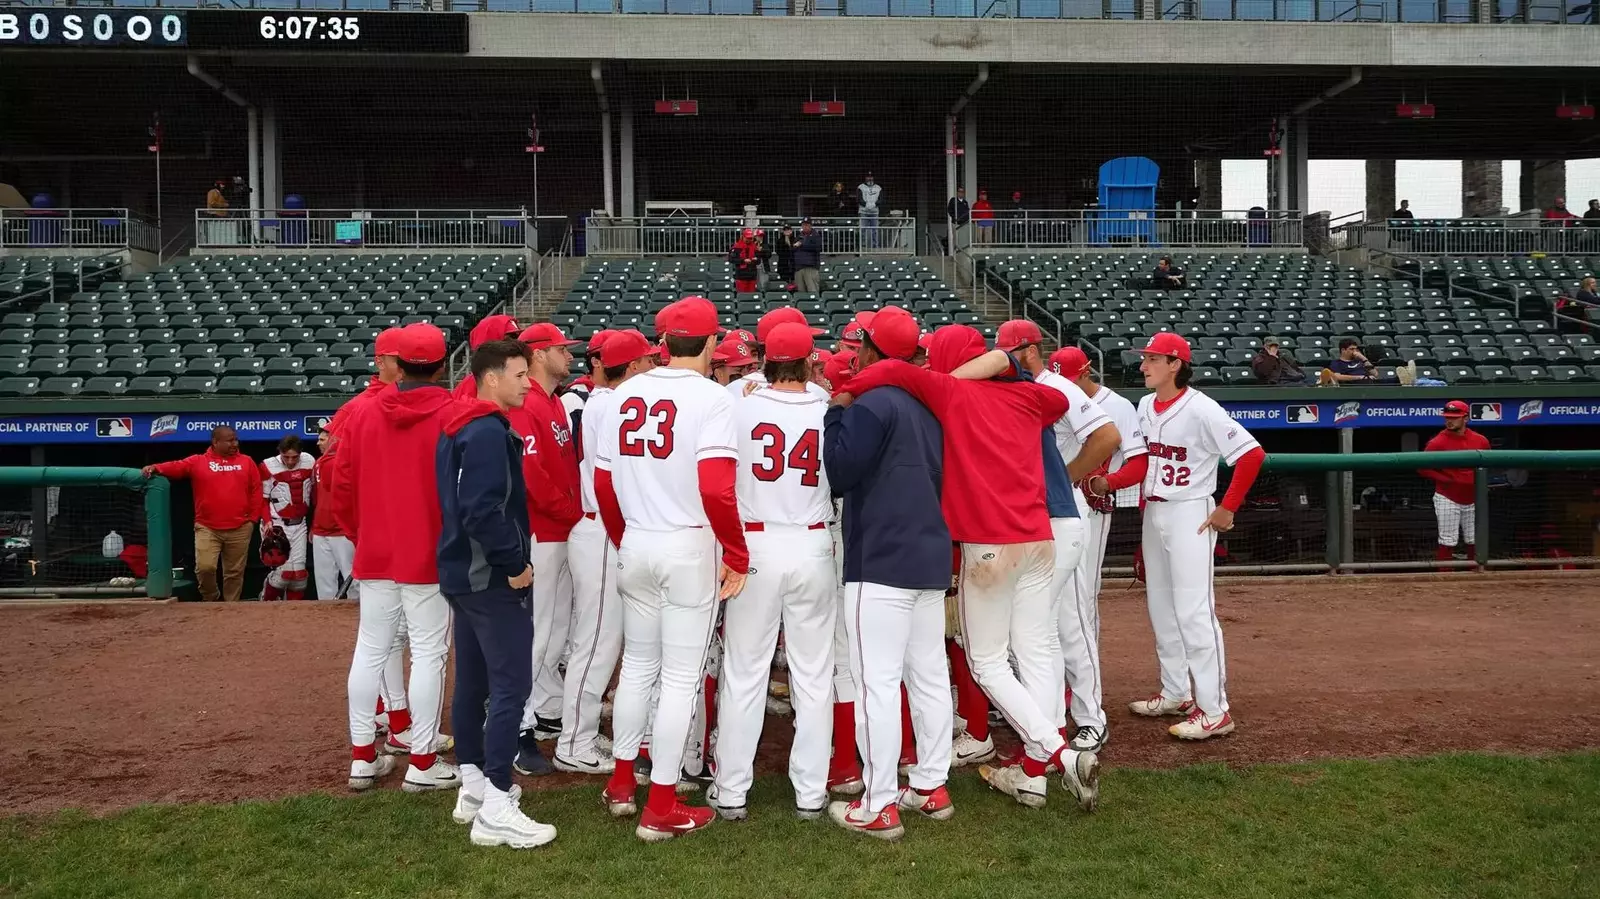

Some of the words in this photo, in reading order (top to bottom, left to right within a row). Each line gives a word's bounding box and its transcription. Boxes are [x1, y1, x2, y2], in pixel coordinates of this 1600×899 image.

[0, 14, 20, 40] B
[29, 13, 50, 40] 0
[62, 14, 84, 41] S
[93, 14, 113, 41] 0
[162, 14, 182, 42] 0
[260, 16, 360, 40] 6:07:35
[1268, 409, 1281, 419] OF
[1366, 407, 1407, 417] OFFICIAL
[1409, 407, 1445, 416] PARTNE
[1549, 405, 1589, 415] OFFICIAL
[25, 422, 73, 432] PARTNER
[75, 422, 90, 432] OF
[235, 420, 281, 431] PARTNER
[283, 420, 298, 430] OF
[619, 396, 678, 460] 23
[751, 421, 821, 487] 34
[1161, 464, 1191, 487] 32
